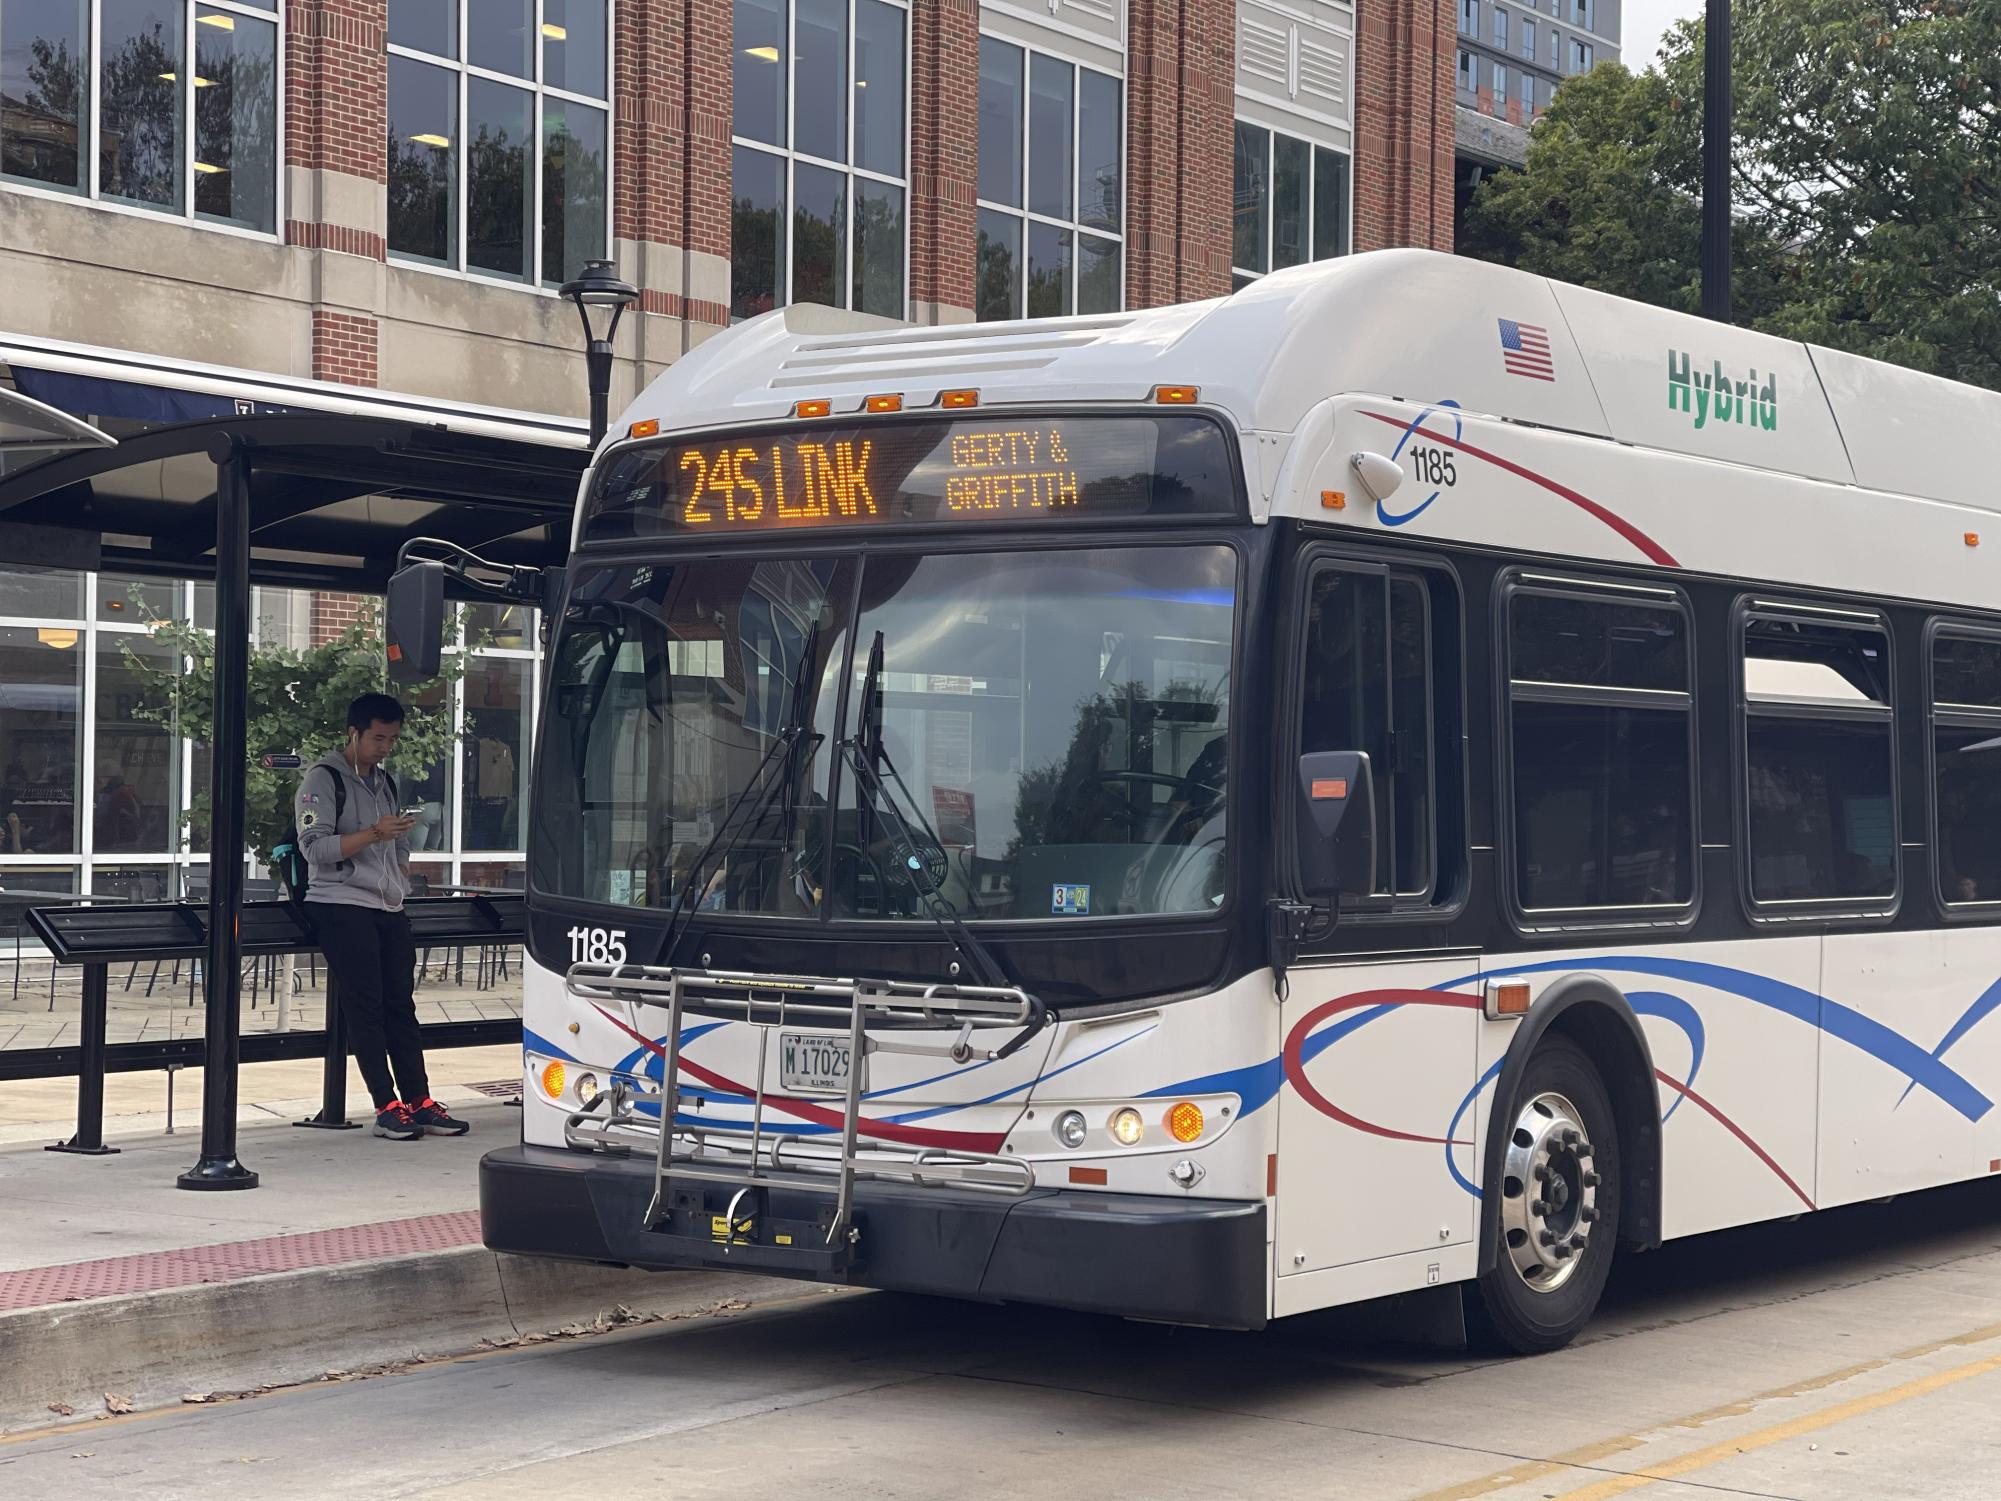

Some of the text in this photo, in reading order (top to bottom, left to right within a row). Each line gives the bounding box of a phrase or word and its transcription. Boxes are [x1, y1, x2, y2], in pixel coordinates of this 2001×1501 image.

[1668, 348, 1777, 431] Hybrid
[952, 429, 1068, 468] GERTY &
[1410, 445, 1456, 487] 1185
[680, 440, 878, 523] 24S LINK
[947, 471, 1077, 509] GRIFFITH
[1056, 888, 1064, 905] 3
[567, 926, 627, 964] 1185
[785, 1047, 796, 1074] M
